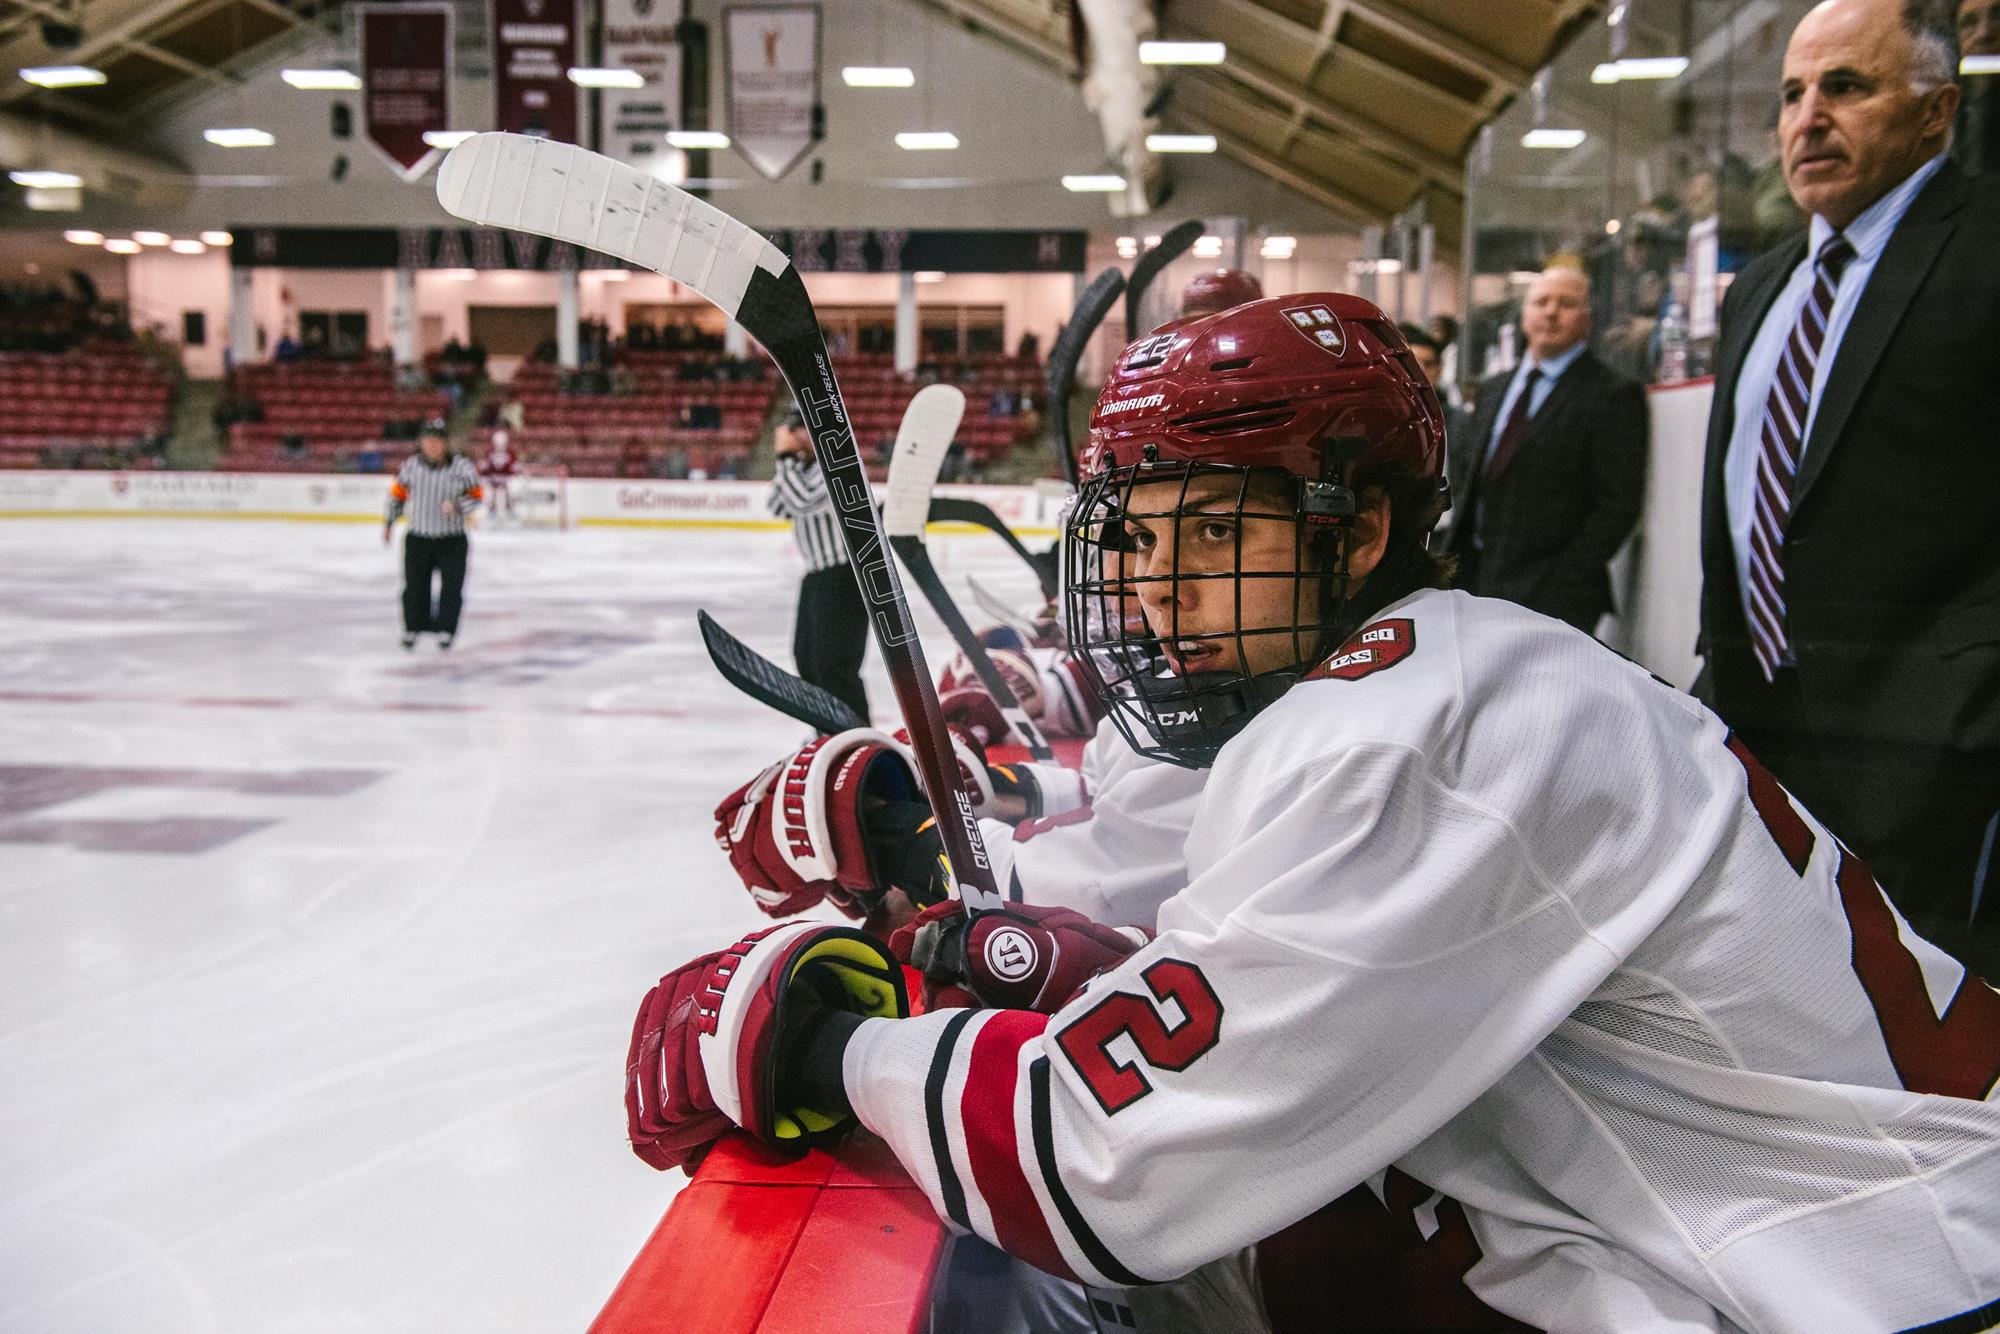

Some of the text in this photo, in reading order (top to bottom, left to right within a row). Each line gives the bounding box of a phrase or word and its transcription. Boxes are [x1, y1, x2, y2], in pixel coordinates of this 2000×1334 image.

[814, 352, 845, 423] QUICK RELEASE
[1101, 394, 1166, 417] WARRIOR
[801, 386, 919, 647] COVERT
[1304, 514, 1341, 524] CCM
[1145, 707, 1202, 726] CCM
[1054, 956, 1225, 1118] 2
